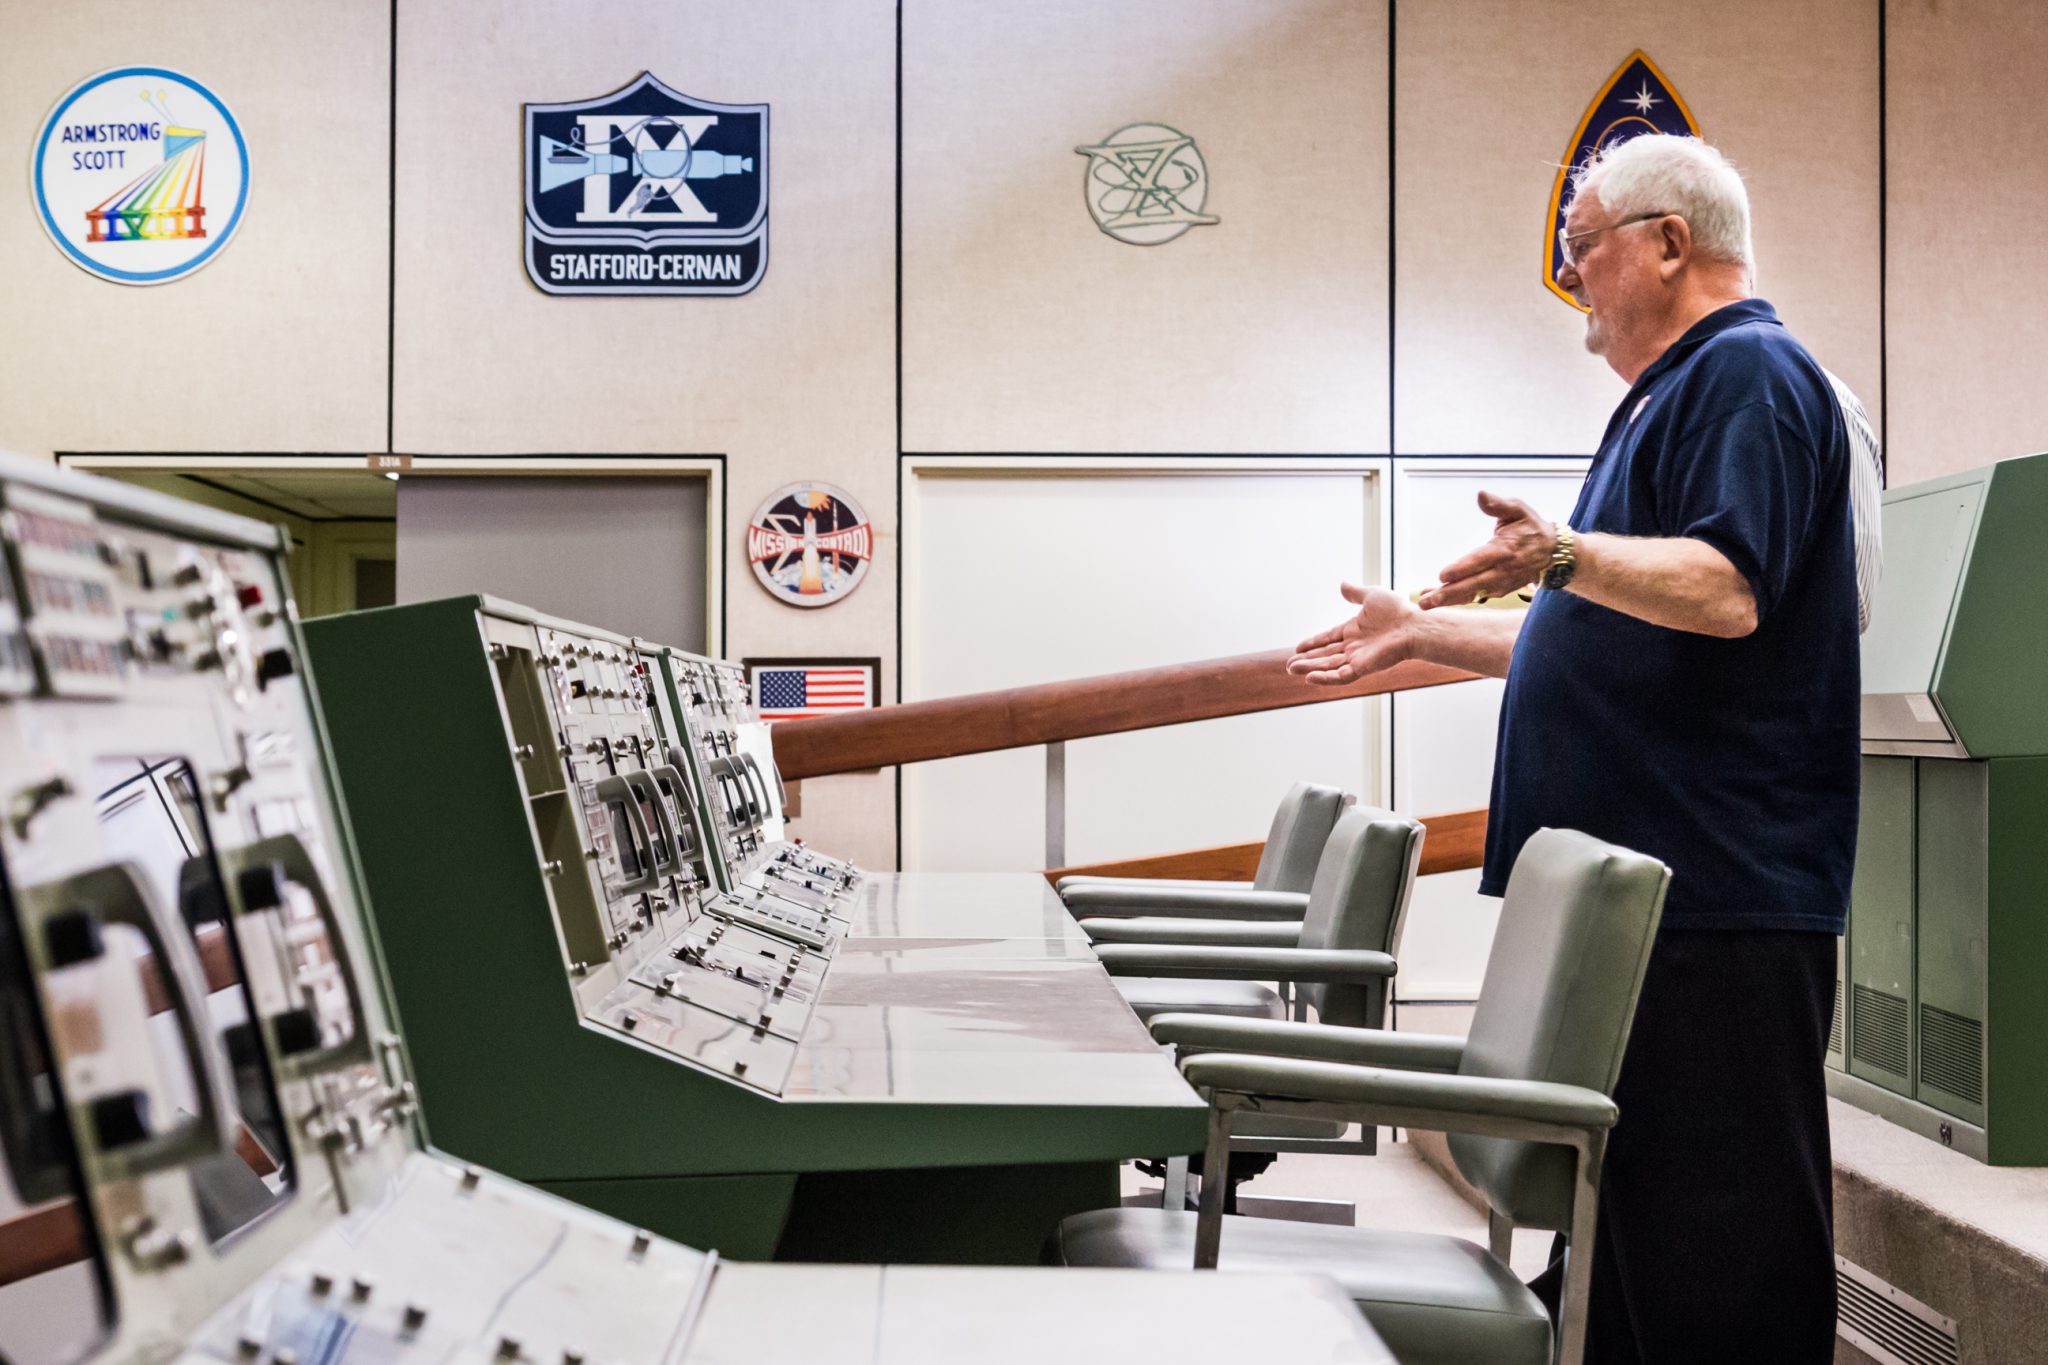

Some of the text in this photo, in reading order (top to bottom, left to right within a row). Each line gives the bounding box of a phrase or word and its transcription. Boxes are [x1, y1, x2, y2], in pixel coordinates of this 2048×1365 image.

[61, 122, 161, 143] ARMSTRONG
[73, 150, 126, 170] SCOTT
[576, 115, 718, 222] IX
[550, 254, 742, 280] STAFFORD-CERNAN
